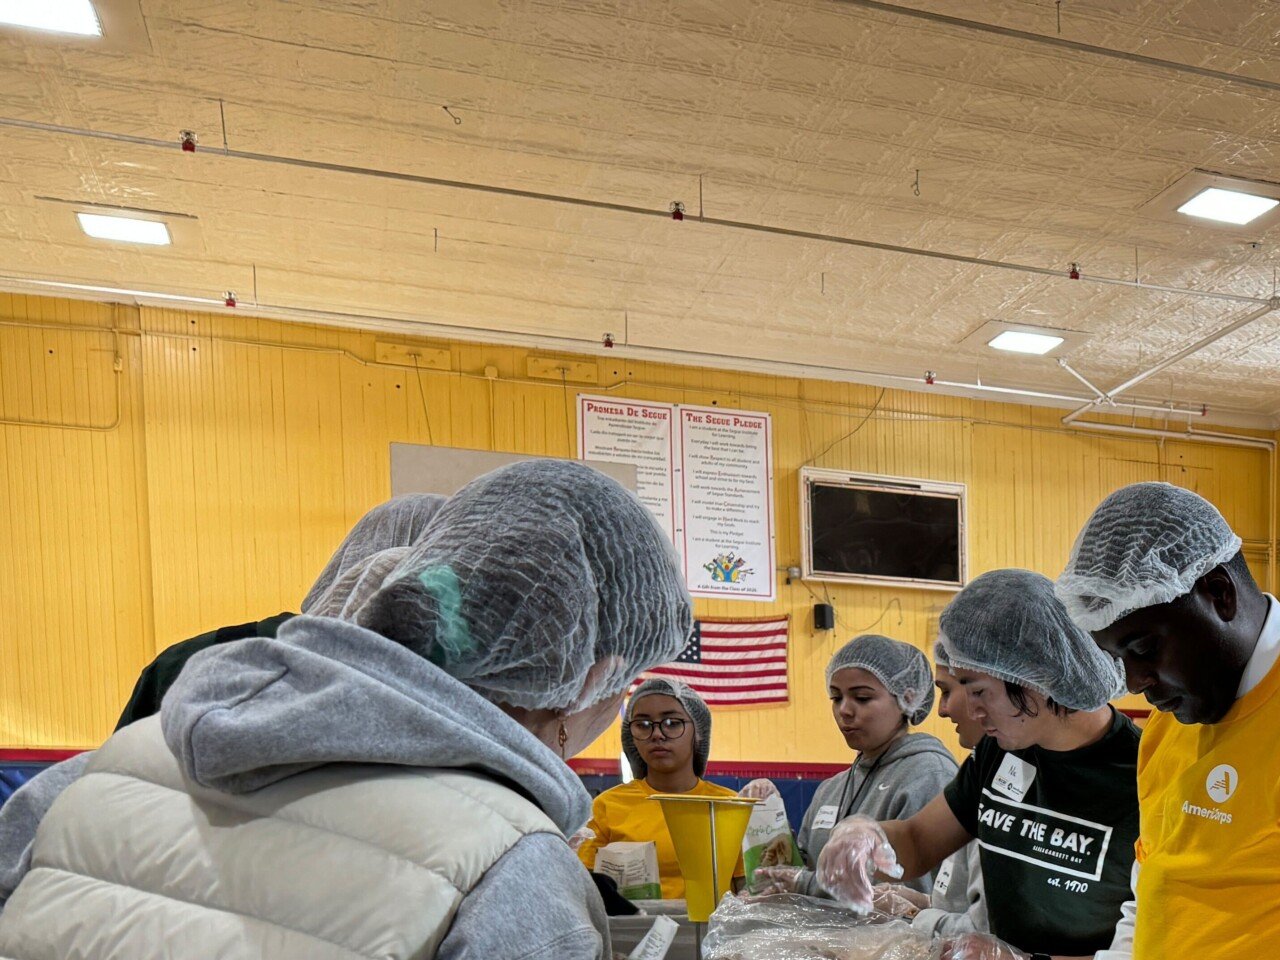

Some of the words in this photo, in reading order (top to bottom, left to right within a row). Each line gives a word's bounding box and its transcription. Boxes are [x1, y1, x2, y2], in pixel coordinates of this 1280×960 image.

[587, 403, 624, 415] PROMESA
[627, 407, 639, 416] DE
[642, 409, 668, 420] SEGUE
[686, 413, 702, 422] THE
[706, 415, 730, 425] SEGUE
[734, 418, 762, 429] PLEDGE
[1020, 818, 1048, 842] THE
[1050, 828, 1095, 856] BAY.
[1064, 880, 1088, 893] 1970
